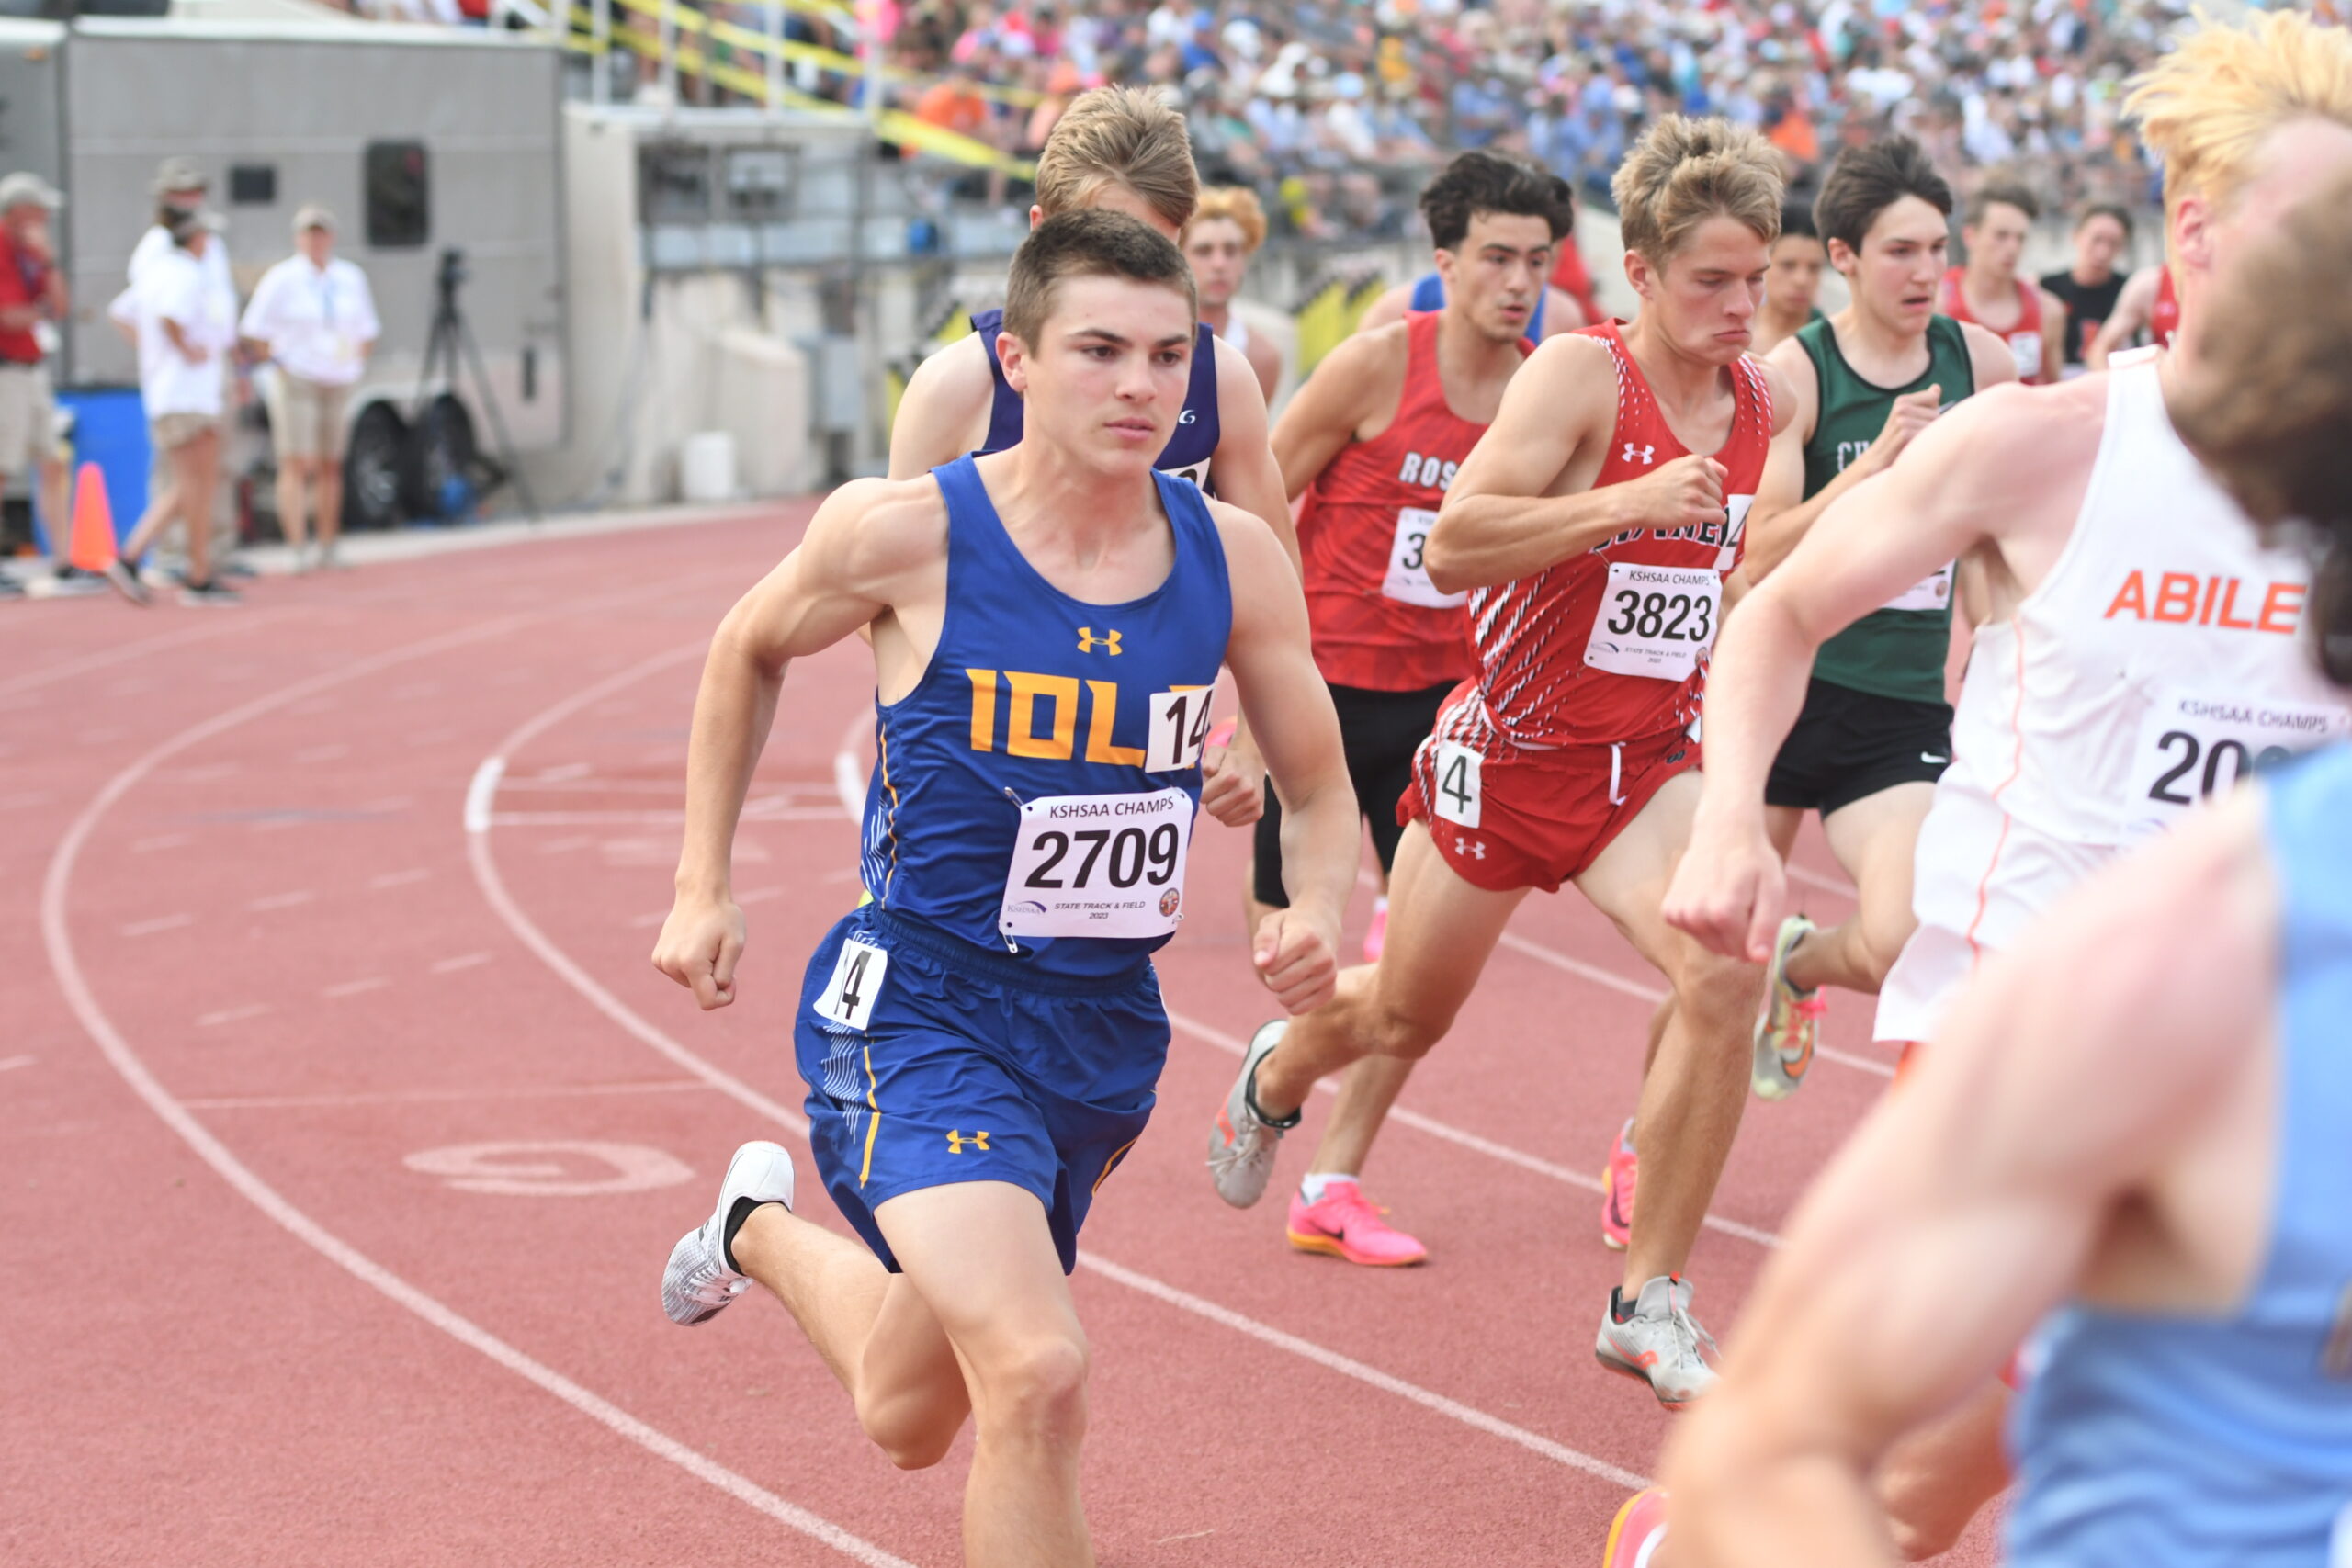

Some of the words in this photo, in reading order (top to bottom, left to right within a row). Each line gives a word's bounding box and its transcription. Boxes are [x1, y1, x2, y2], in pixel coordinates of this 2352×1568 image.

[1629, 570, 1669, 583] KSHSAA
[1672, 574, 1710, 586] CHAMPS
[2103, 570, 2308, 635] ABILE
[1608, 590, 1712, 642] 3823
[965, 668, 1209, 769] IOL
[1165, 689, 1213, 764] 14
[2257, 709, 2329, 734] CHAMPS
[1049, 802, 1110, 818] KSHSAA
[1114, 795, 1175, 816] CHAMPS
[1442, 755, 1472, 814] 4
[1024, 823, 1179, 889] 2709
[1122, 900, 1146, 909] FIELD
